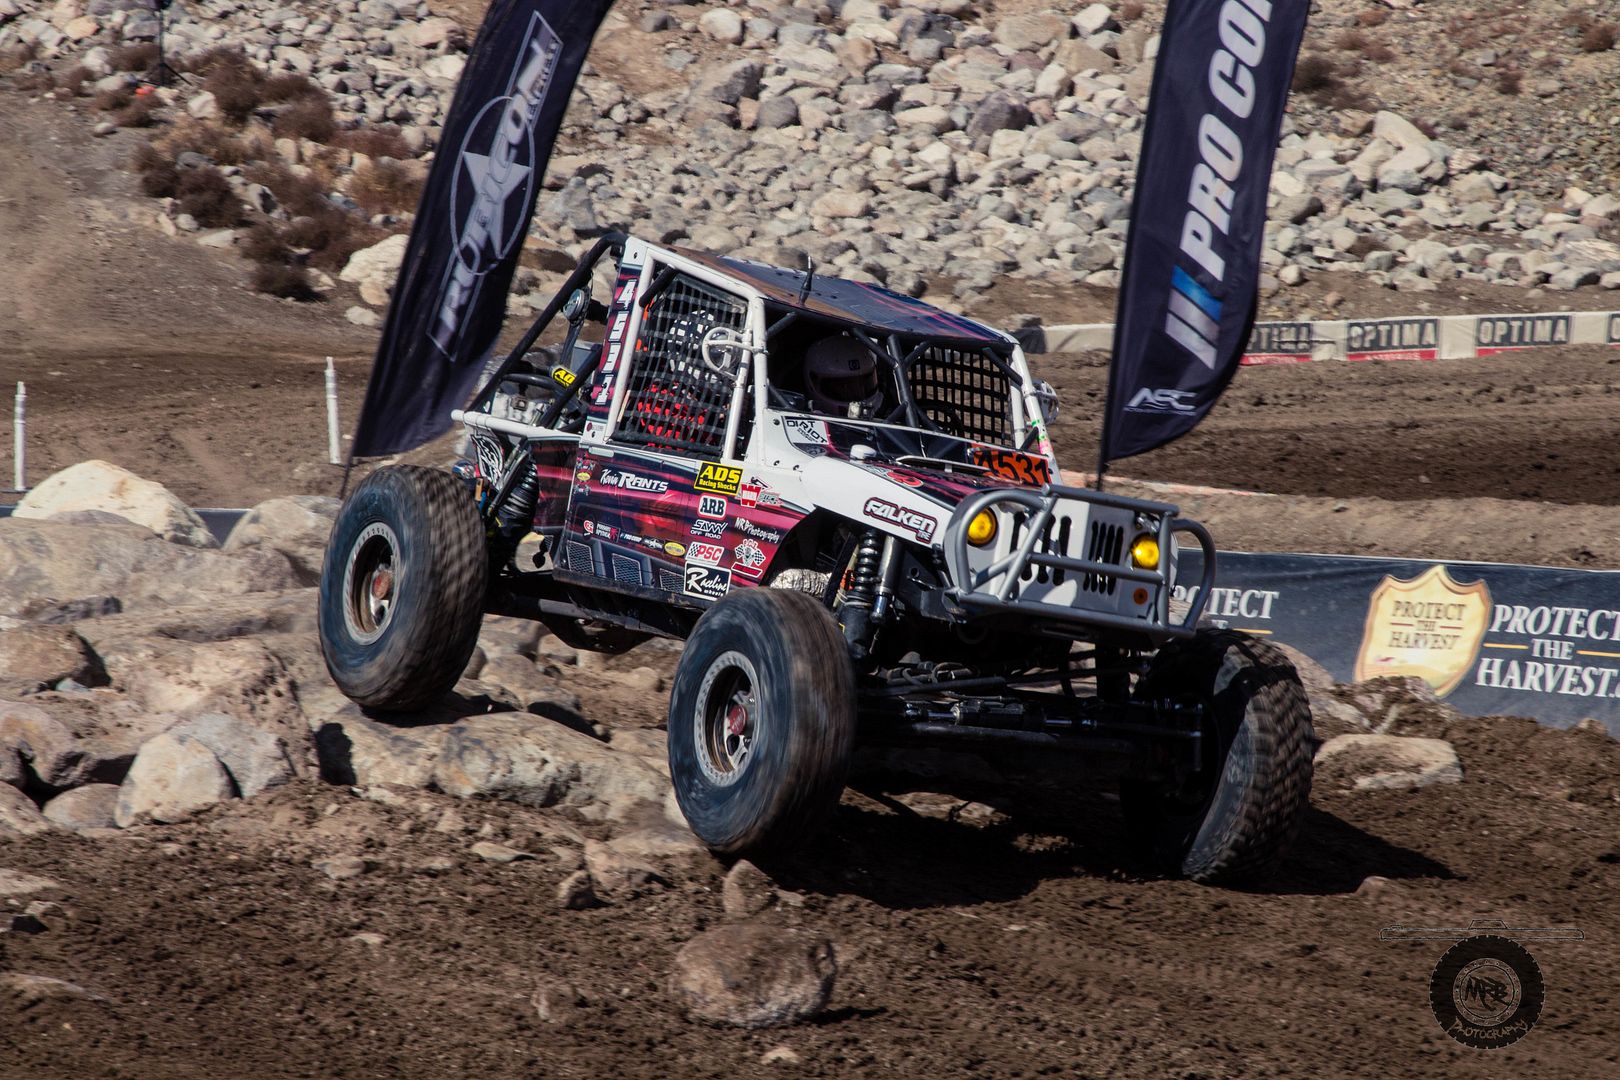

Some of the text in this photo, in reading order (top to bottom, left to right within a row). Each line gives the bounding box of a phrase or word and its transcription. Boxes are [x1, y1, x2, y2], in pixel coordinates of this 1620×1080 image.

[1180, 113, 1244, 282] PRO
[1247, 326, 1310, 351] PTIMA
[1350, 322, 1437, 349] OPTIMA
[1479, 318, 1568, 344] OPTIMA
[699, 465, 741, 484] ADS
[700, 497, 725, 516] ARB
[865, 499, 937, 534] FALKEN
[704, 532, 722, 540] ROAD
[696, 544, 723, 561] PSC
[1391, 600, 1468, 621] PROTECT
[1387, 631, 1462, 650] HARVEST
[1531, 638, 1575, 660] THE
